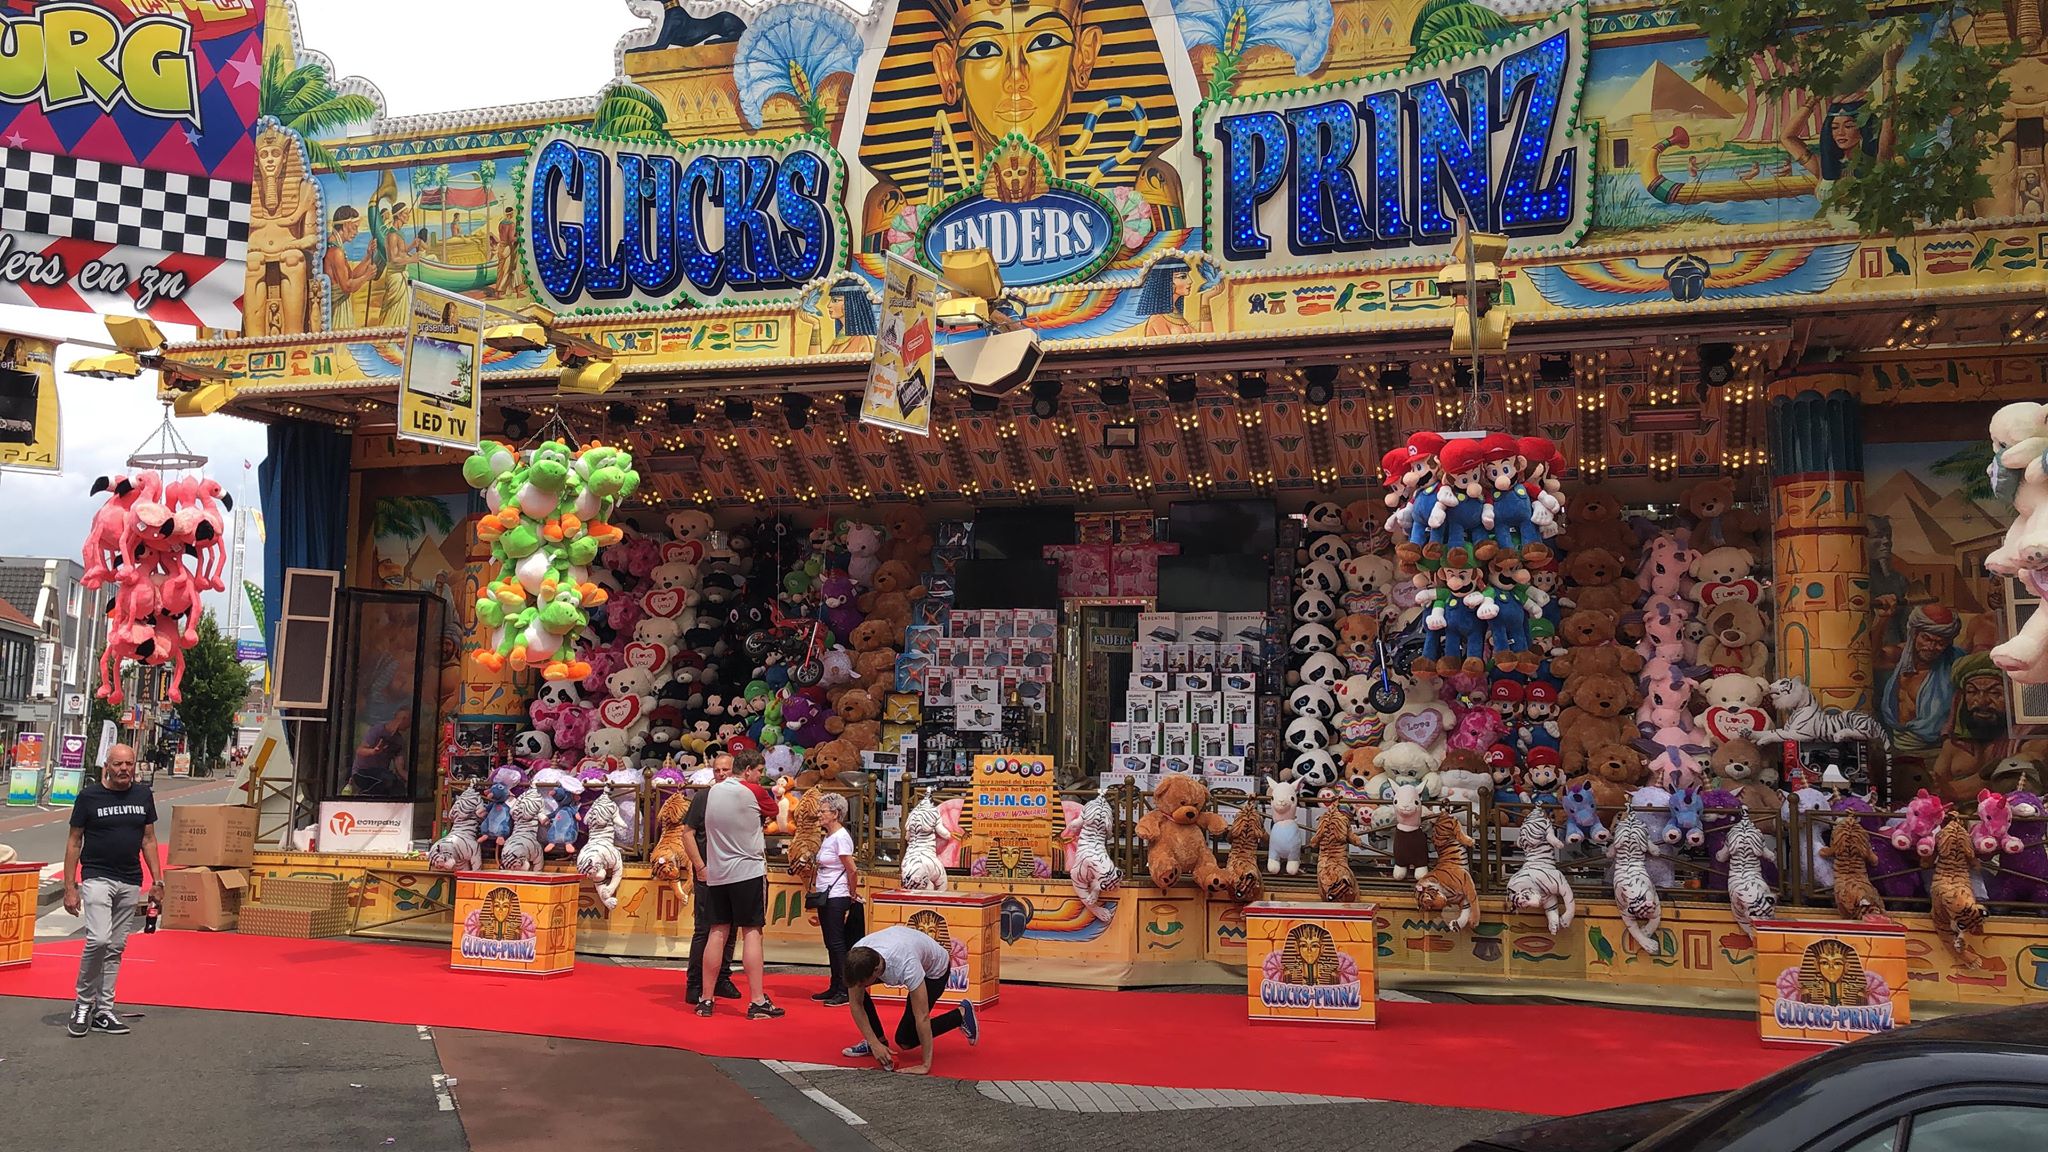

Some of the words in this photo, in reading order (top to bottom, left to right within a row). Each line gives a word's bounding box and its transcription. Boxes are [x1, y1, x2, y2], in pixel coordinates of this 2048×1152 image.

[1217, 30, 1577, 256] PRINZ
[943, 207, 1093, 264] ENDERS
[80, 261, 126, 293] en
[135, 267, 186, 309] zn
[413, 410, 443, 432] LED
[447, 417, 467, 437] TV
[4, 449, 52, 464] PS4
[979, 794, 1047, 806] B.I.N.G.O
[188, 827, 207, 835] 41035
